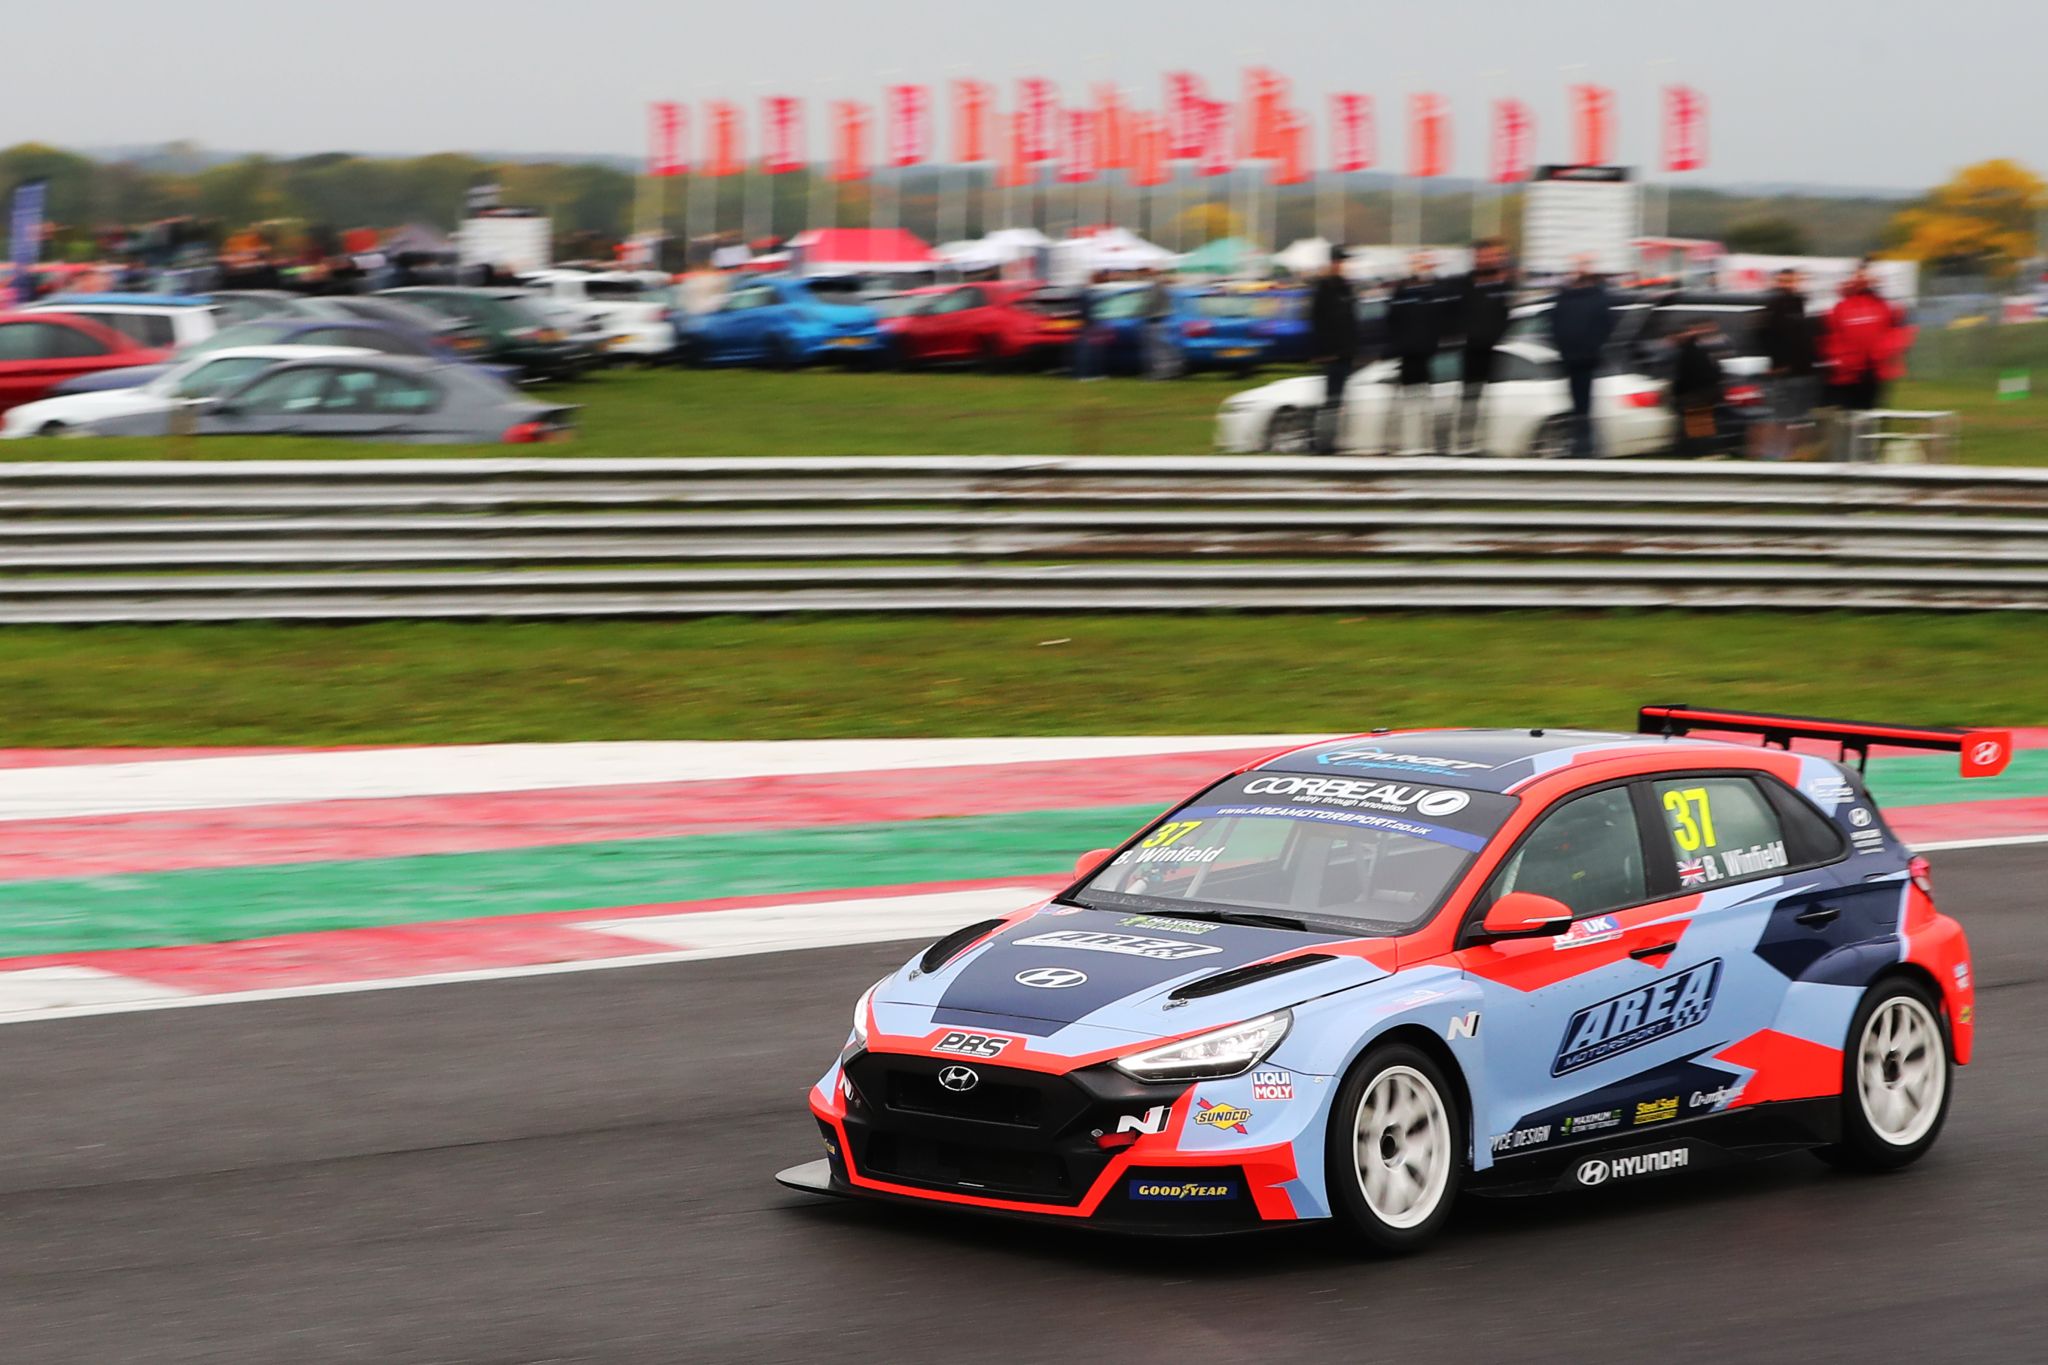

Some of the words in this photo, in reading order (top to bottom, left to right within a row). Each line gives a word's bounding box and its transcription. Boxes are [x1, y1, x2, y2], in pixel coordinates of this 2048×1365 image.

[1242, 776, 1430, 806] CORBEAU
[1321, 796, 1359, 807] through
[1358, 800, 1408, 813] innovation
[1662, 787, 1717, 851] 37
[1141, 821, 1203, 849] 37
[1110, 850, 1134, 866] B.
[1135, 846, 1225, 863] Winfield
[1721, 840, 1790, 877] Winfield
[1581, 917, 1613, 934] UK
[1564, 965, 1716, 1050] AREA
[936, 1032, 1009, 1056] PRS
[1563, 1023, 1666, 1067] MOTORSPORT
[1254, 1072, 1291, 1085] LIQUI
[1254, 1085, 1293, 1099] MOLY
[1199, 1110, 1249, 1123] SUNOCO
[1513, 1125, 1552, 1147] DESIGN
[1612, 1147, 1689, 1178] HYUNDAI
[1138, 1183, 1228, 1199] GOODYEAR
